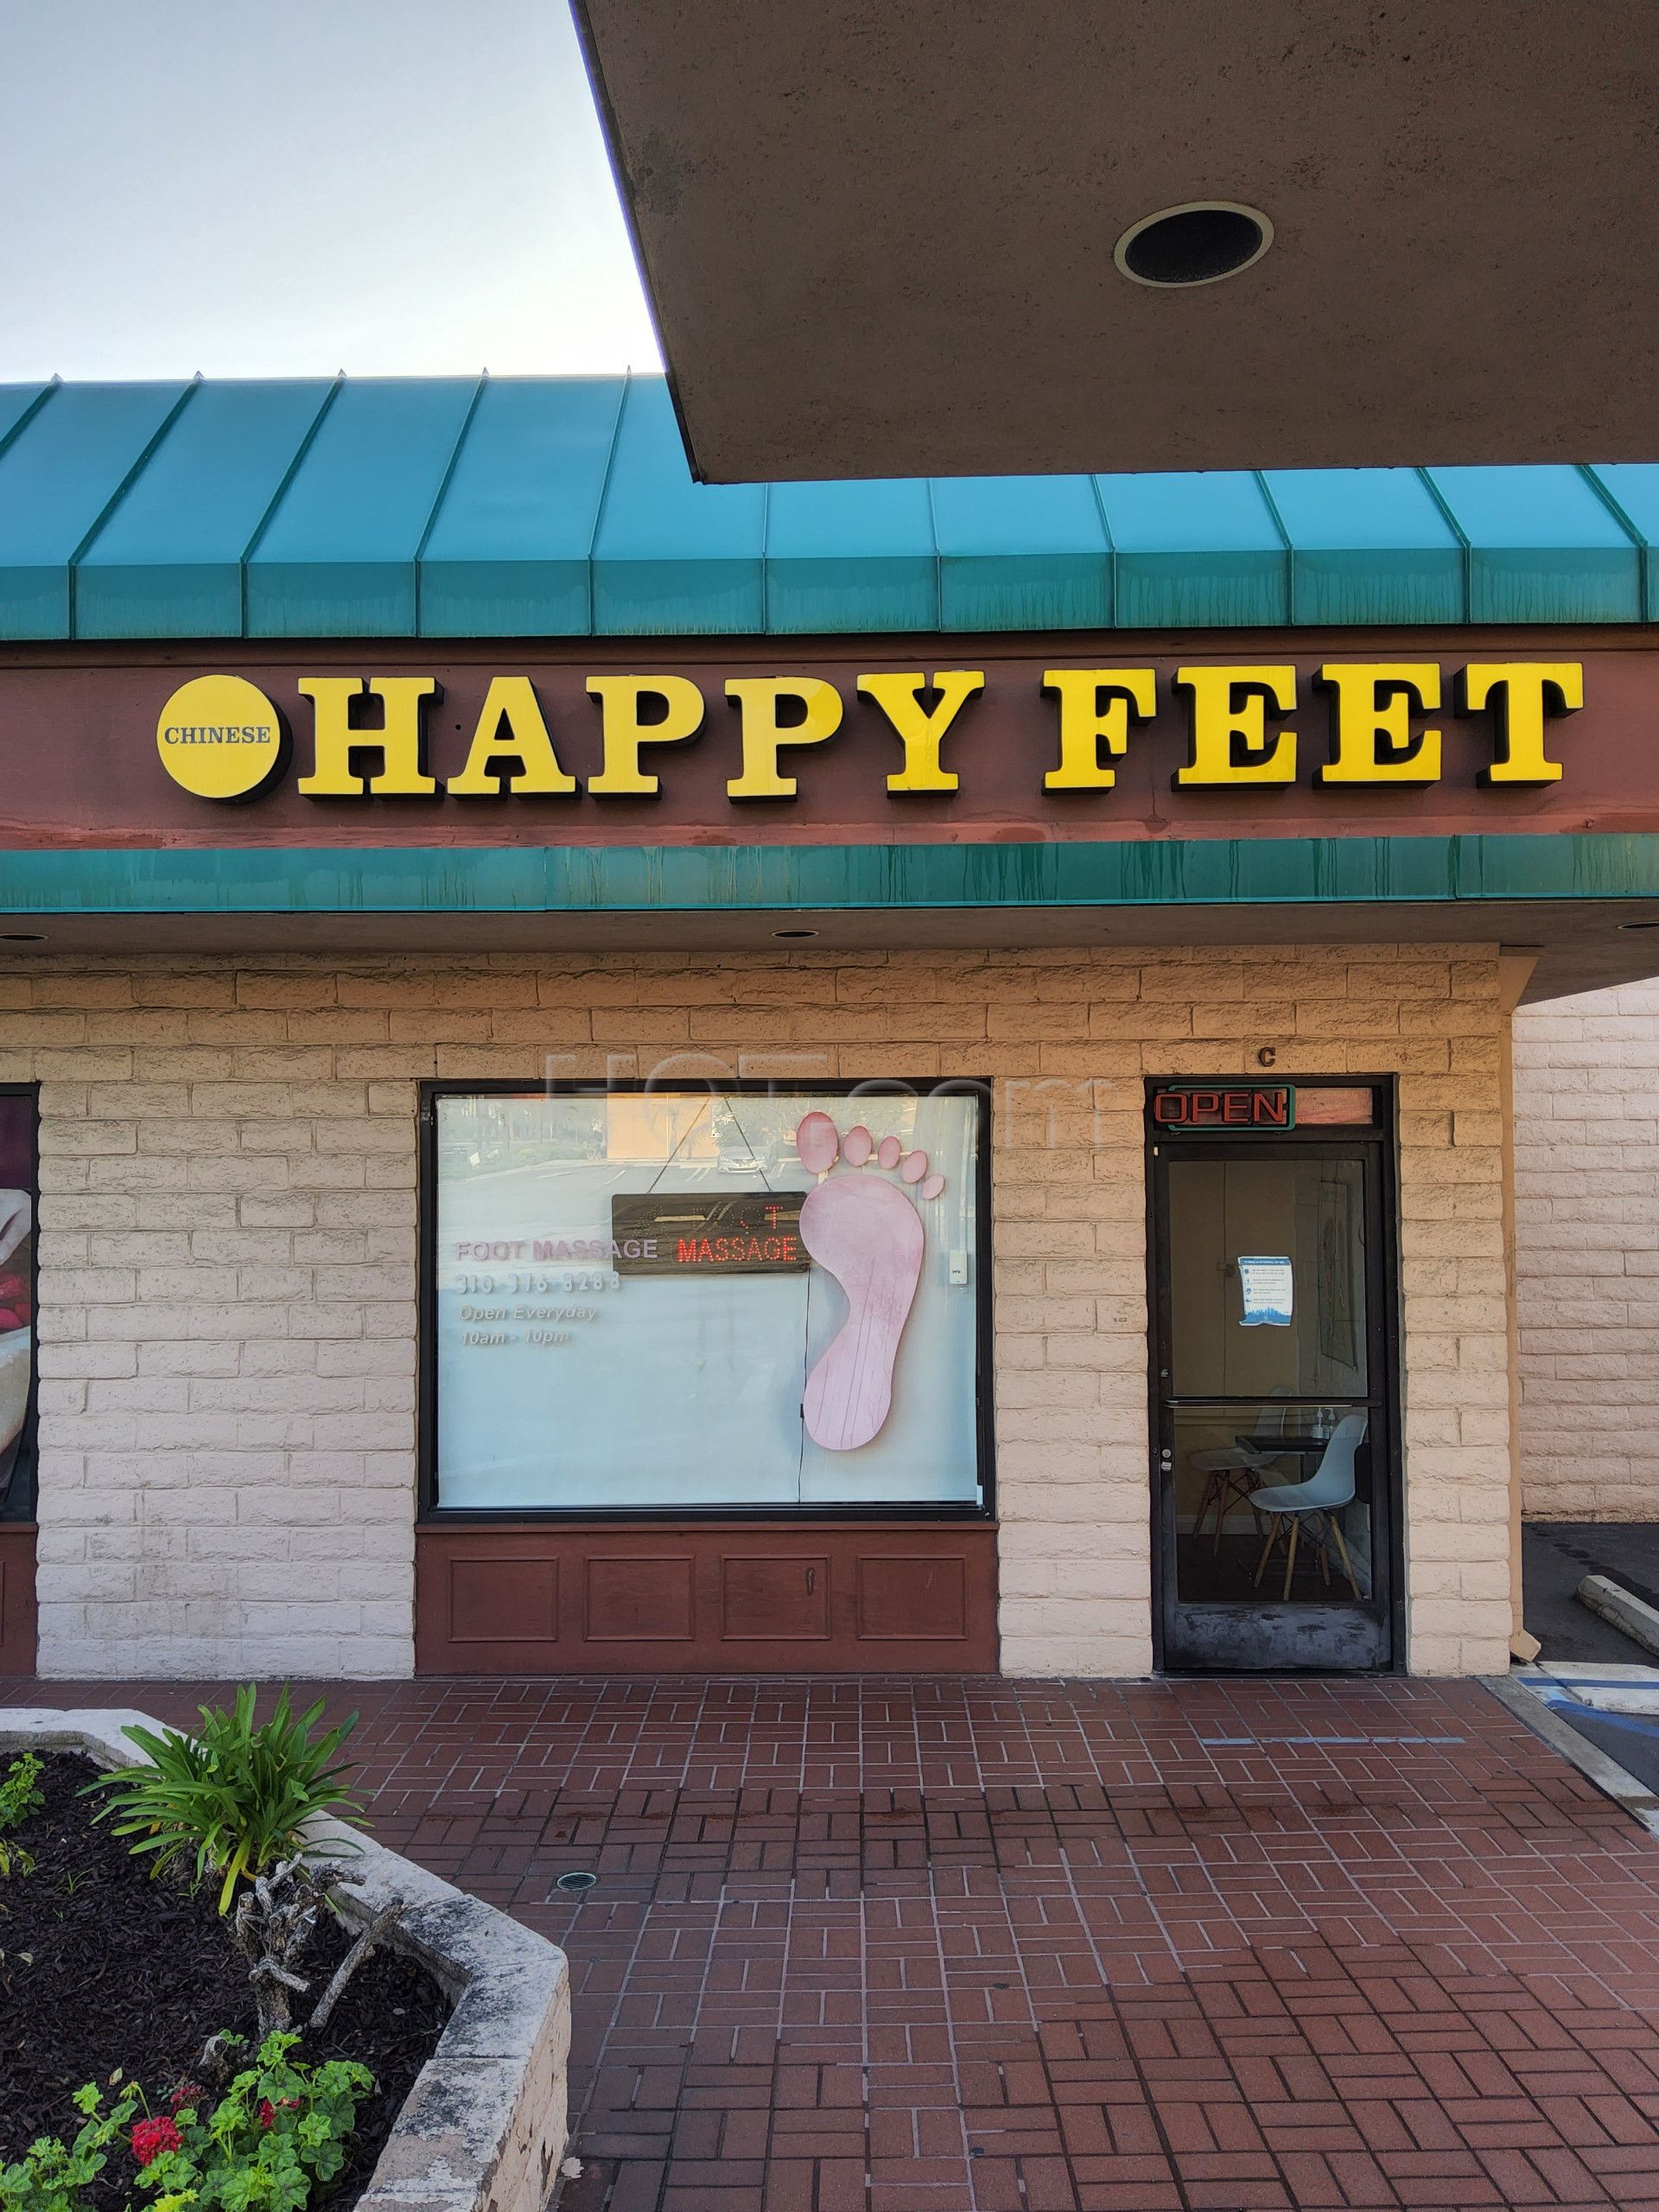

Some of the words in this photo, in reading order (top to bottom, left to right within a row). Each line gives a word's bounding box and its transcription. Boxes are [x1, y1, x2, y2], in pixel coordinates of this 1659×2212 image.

[164, 727, 270, 744] CHINESE
[297, 671, 985, 797] HAPPY
[1042, 663, 1583, 789] FEET
[1258, 1046, 1276, 1067] C
[1154, 1091, 1284, 1122] OPEN
[455, 1240, 524, 1261] FOOT
[532, 1239, 658, 1260] MASSAGE
[677, 1236, 797, 1262] MASSAGE
[459, 1305, 506, 1322] Open
[513, 1305, 597, 1322] Everyday
[461, 1330, 505, 1345] 10am
[524, 1329, 571, 1345] 10pm
